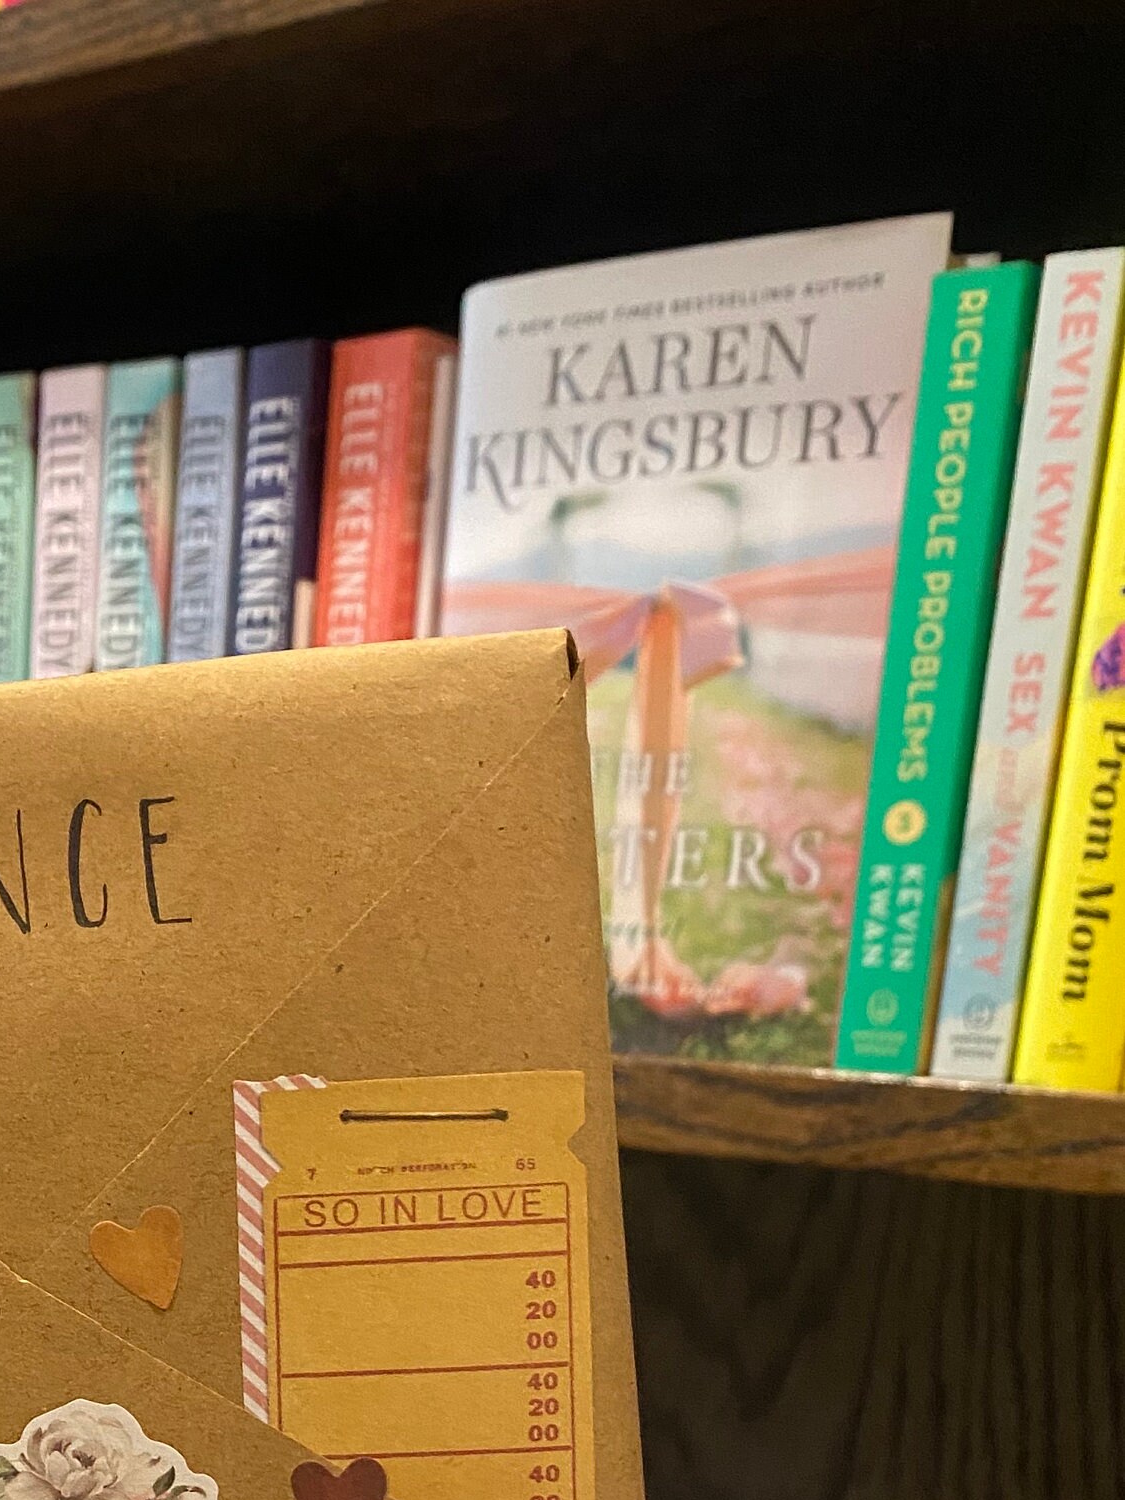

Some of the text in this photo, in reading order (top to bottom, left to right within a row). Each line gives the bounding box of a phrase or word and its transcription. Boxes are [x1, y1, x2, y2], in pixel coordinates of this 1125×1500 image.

[543, 313, 817, 411] KAREN
[107, 413, 151, 492] ELLE
[185, 414, 225, 484] ELLE
[464, 391, 905, 514] KINGSBURY
[1022, 270, 1106, 621] KEVIN KWAN
[36, 412, 88, 674] ELLE KENNEDY
[236, 396, 296, 653] ELLE KENNED
[328, 381, 384, 648] ELLE KENNED
[896, 288, 990, 784] RICH PEOPLE PROBLEMS
[1006, 652, 1045, 735] SEX
[607, 824, 824, 892] TERS
[973, 818, 1023, 977] VANITY
[861, 863, 896, 969] KWAN
[890, 863, 926, 972] KEVIN
[1062, 882, 1116, 1002] Mom
[515, 1158, 537, 1171] 65
[303, 1188, 544, 1228] SO IN LOVE
[525, 1269, 557, 1289] 40
[525, 1299, 557, 1320] 20
[526, 1330, 559, 1350] 00
[527, 1371, 559, 1391] 40
[527, 1397, 560, 1417] 20
[528, 1423, 560, 1442] 00
[528, 1463, 561, 1483] 40
